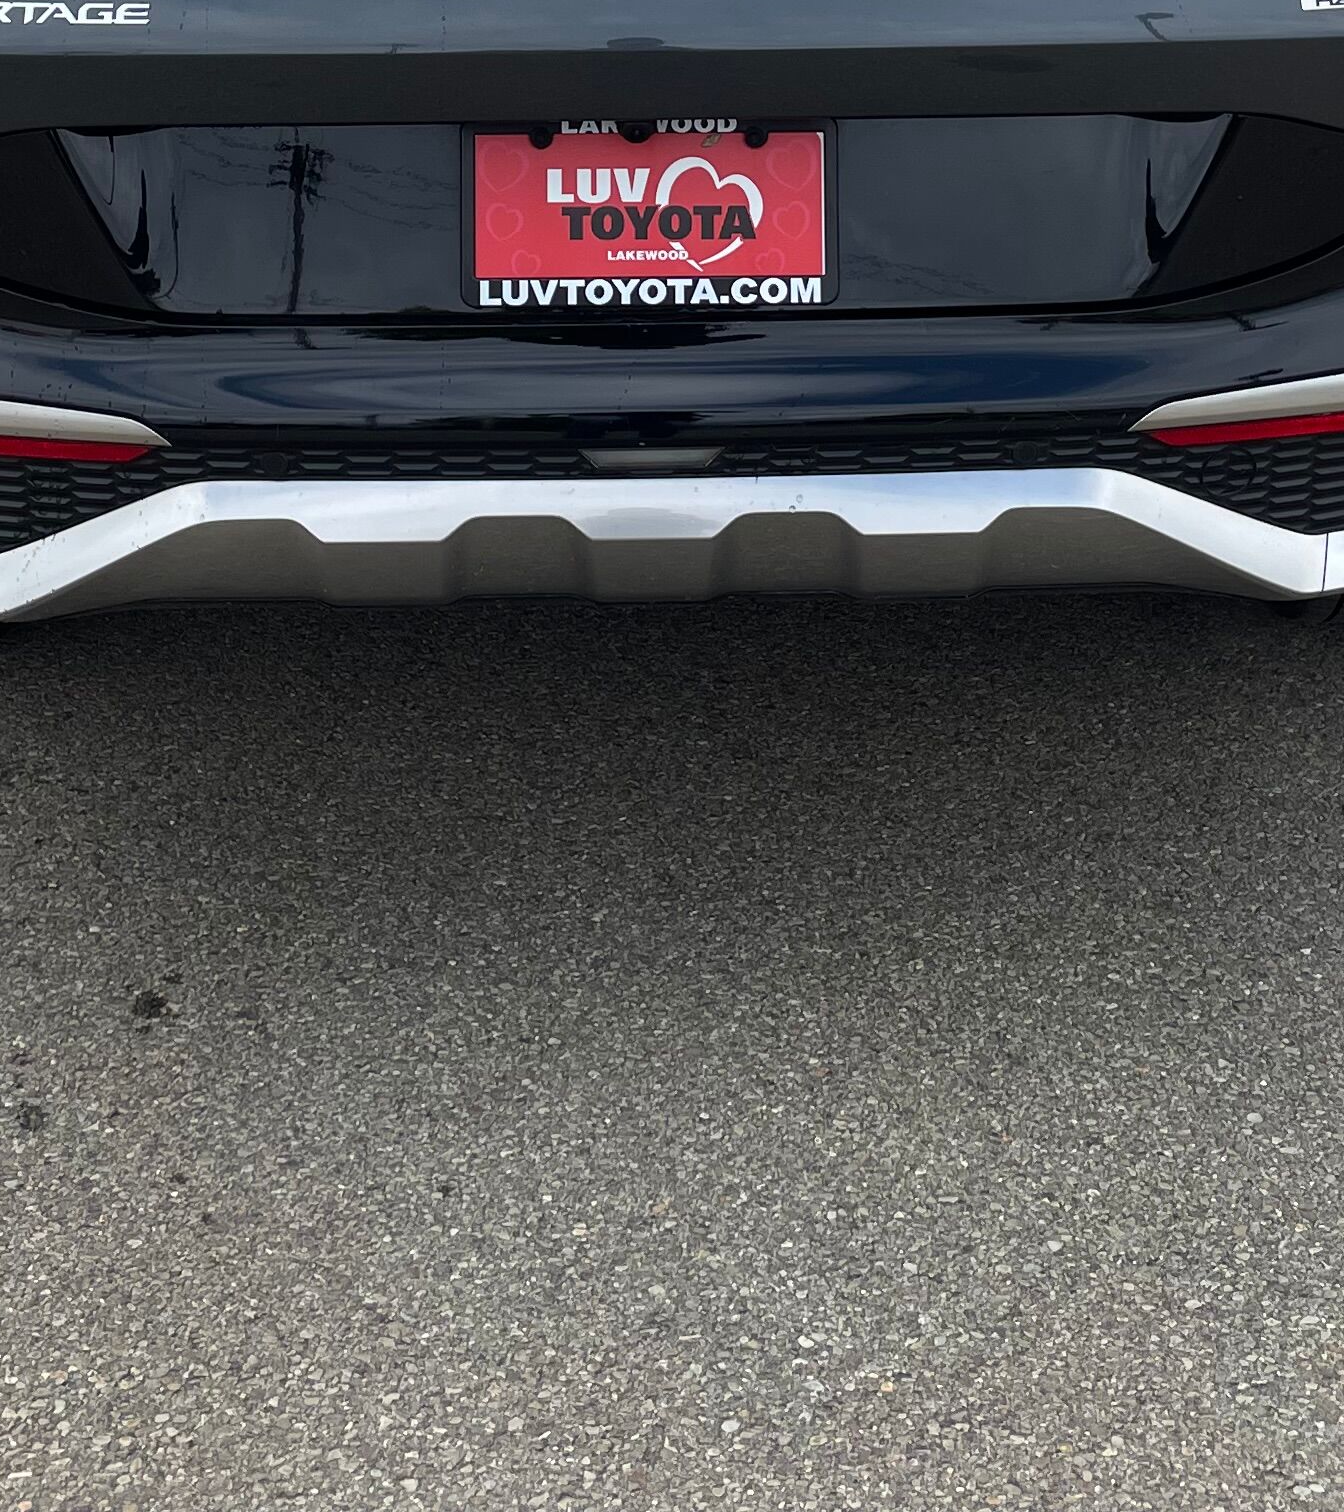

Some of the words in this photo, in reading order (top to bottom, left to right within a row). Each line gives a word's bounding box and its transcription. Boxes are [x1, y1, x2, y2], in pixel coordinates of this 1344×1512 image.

[546, 168, 651, 204] LUV
[561, 205, 757, 240] TOYOTA
[607, 249, 690, 261] LAKEWOOD
[478, 277, 822, 306] LUVTOYOTA.COM
